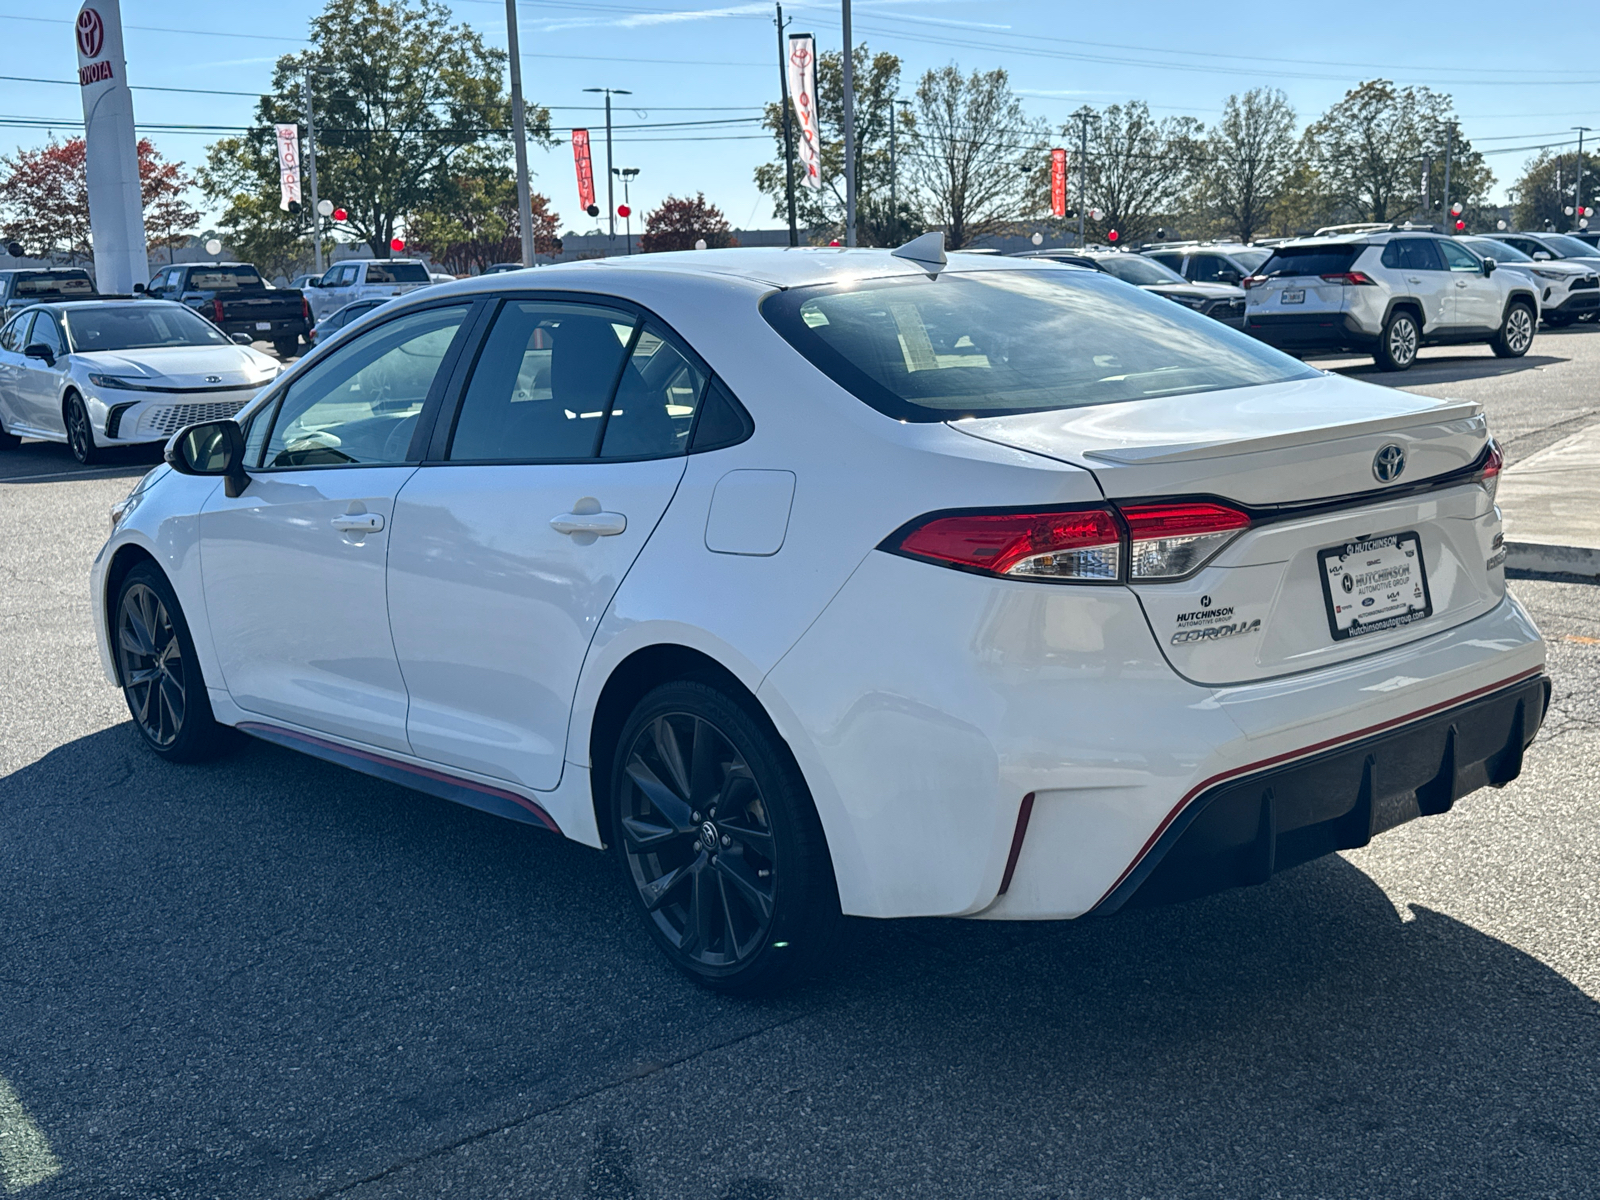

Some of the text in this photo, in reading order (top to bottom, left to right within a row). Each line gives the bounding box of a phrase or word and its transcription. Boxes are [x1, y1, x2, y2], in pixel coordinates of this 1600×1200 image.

[1354, 536, 1397, 554] HUTCHINSON
[1355, 565, 1411, 588] HUTCHINSON
[1358, 577, 1410, 595] AUTOMOTIVE GROUP
[1176, 607, 1234, 622] HUTCHINSON
[1177, 619, 1214, 628] AUTOMOTIVE
[1170, 619, 1261, 646] COROLLA
[1348, 611, 1425, 637] Hutchinsonautogroup.com
